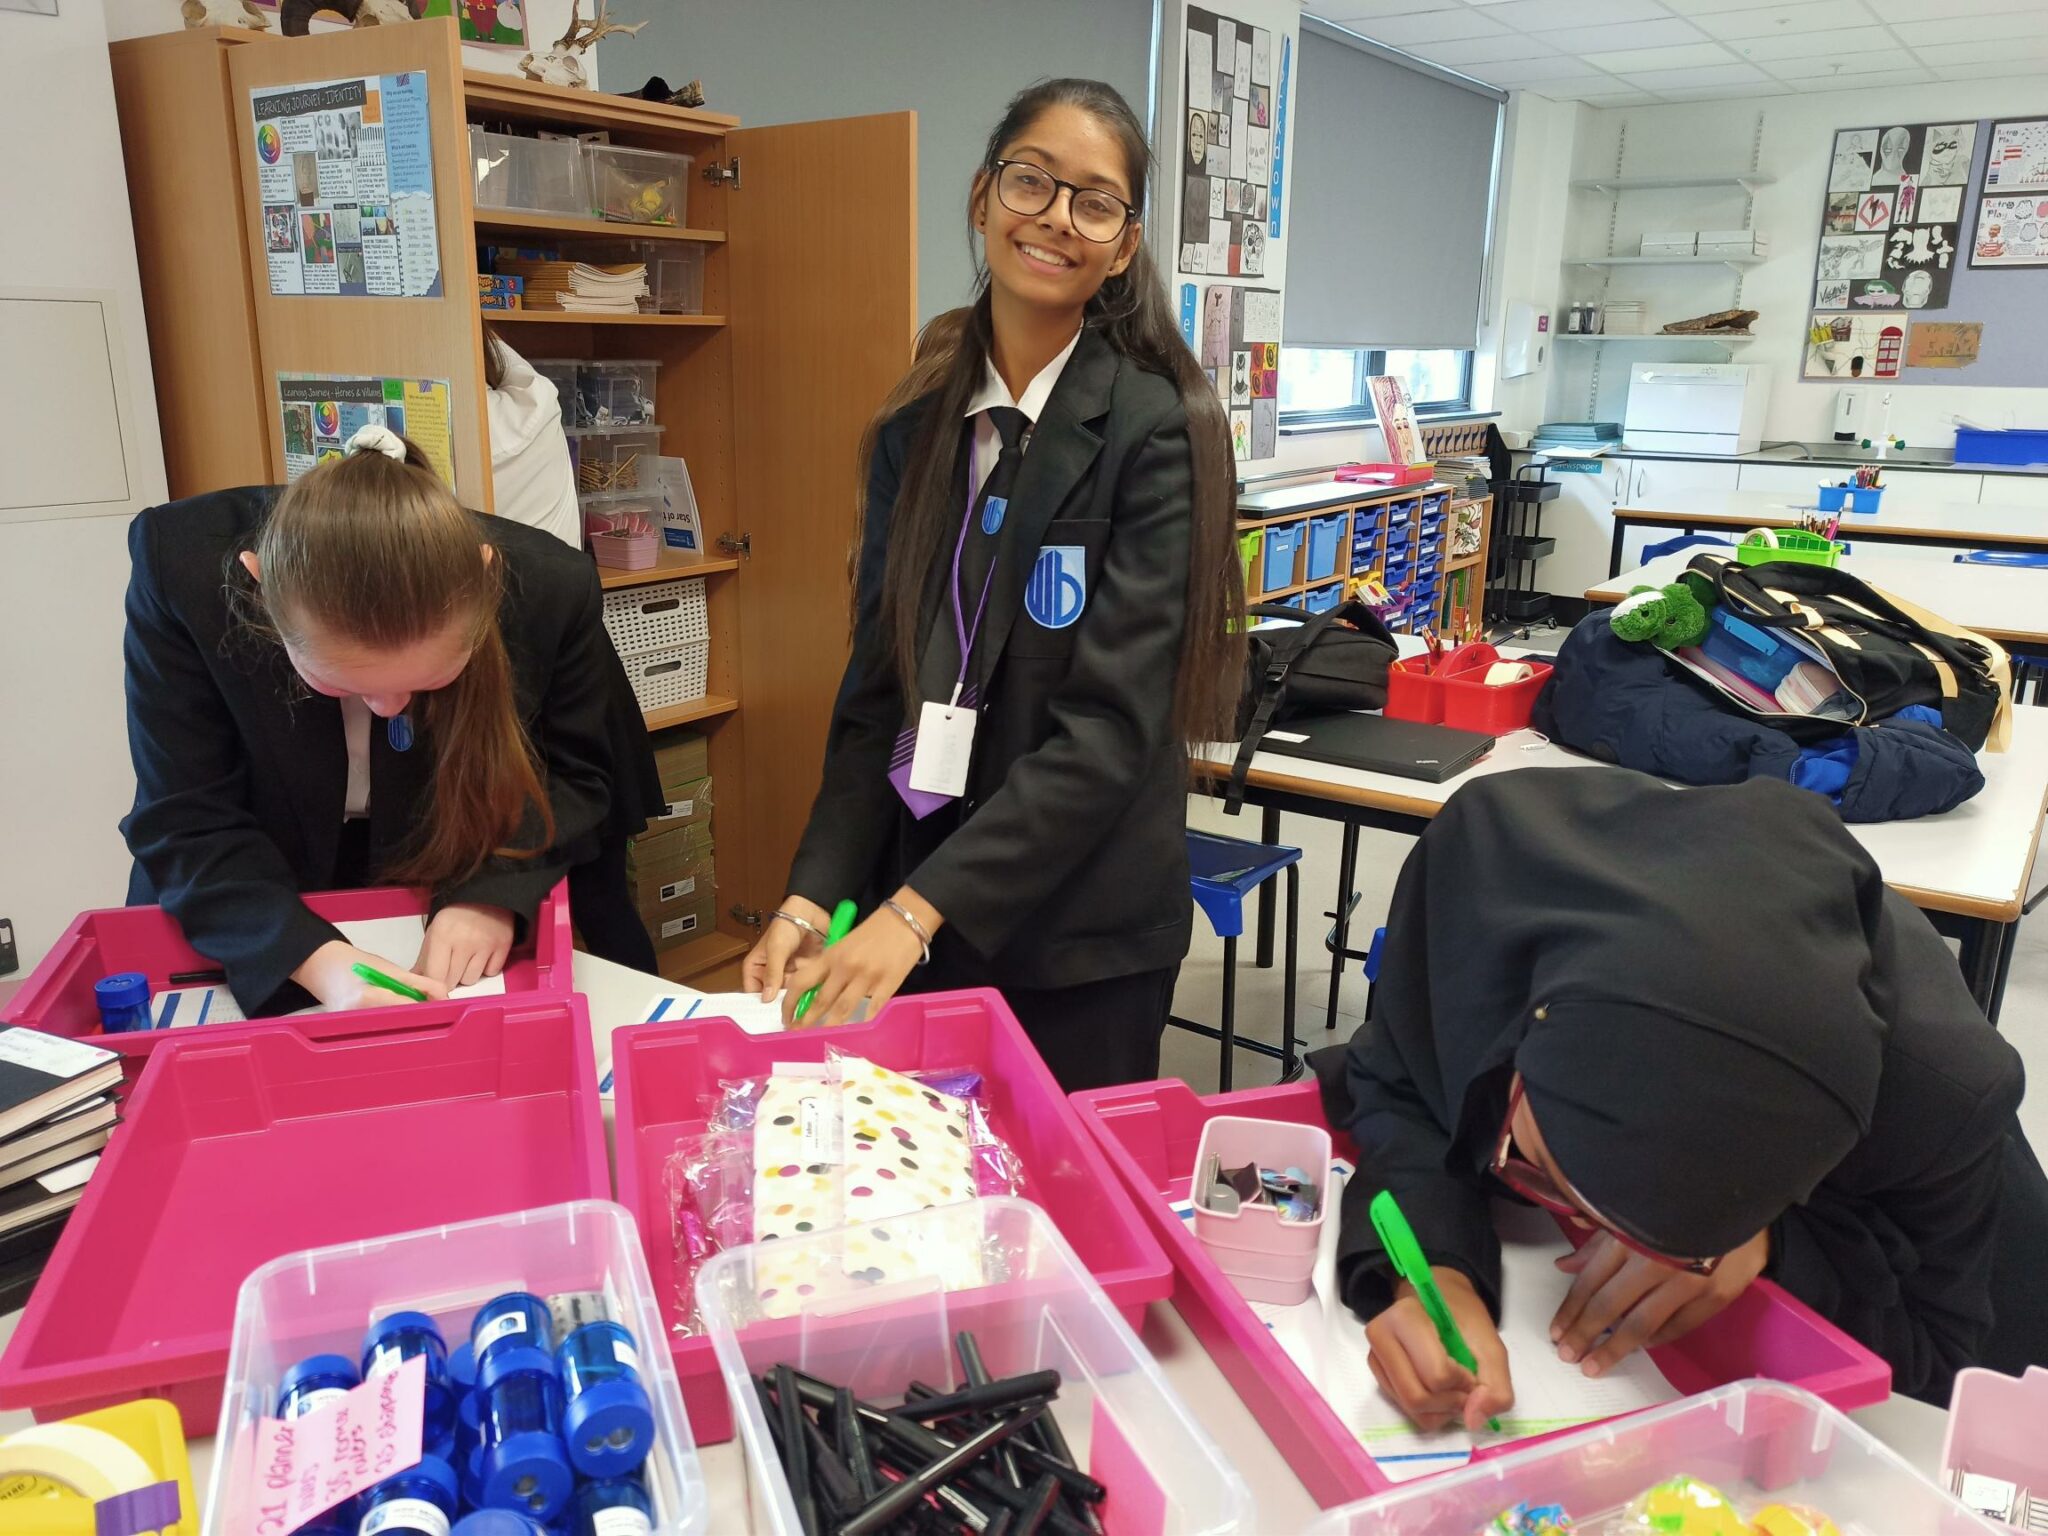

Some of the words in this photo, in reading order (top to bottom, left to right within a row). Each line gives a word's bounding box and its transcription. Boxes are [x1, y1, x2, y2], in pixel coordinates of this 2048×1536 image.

[256, 98, 291, 116] LEARNING
[291, 92, 321, 111] JOURNEY
[325, 85, 362, 105] IDENTITY
[283, 387, 307, 399] Learning
[306, 387, 330, 399] Journey
[334, 386, 355, 397] Heroes
[356, 388, 361, 397] &
[362, 387, 382, 397] Villains
